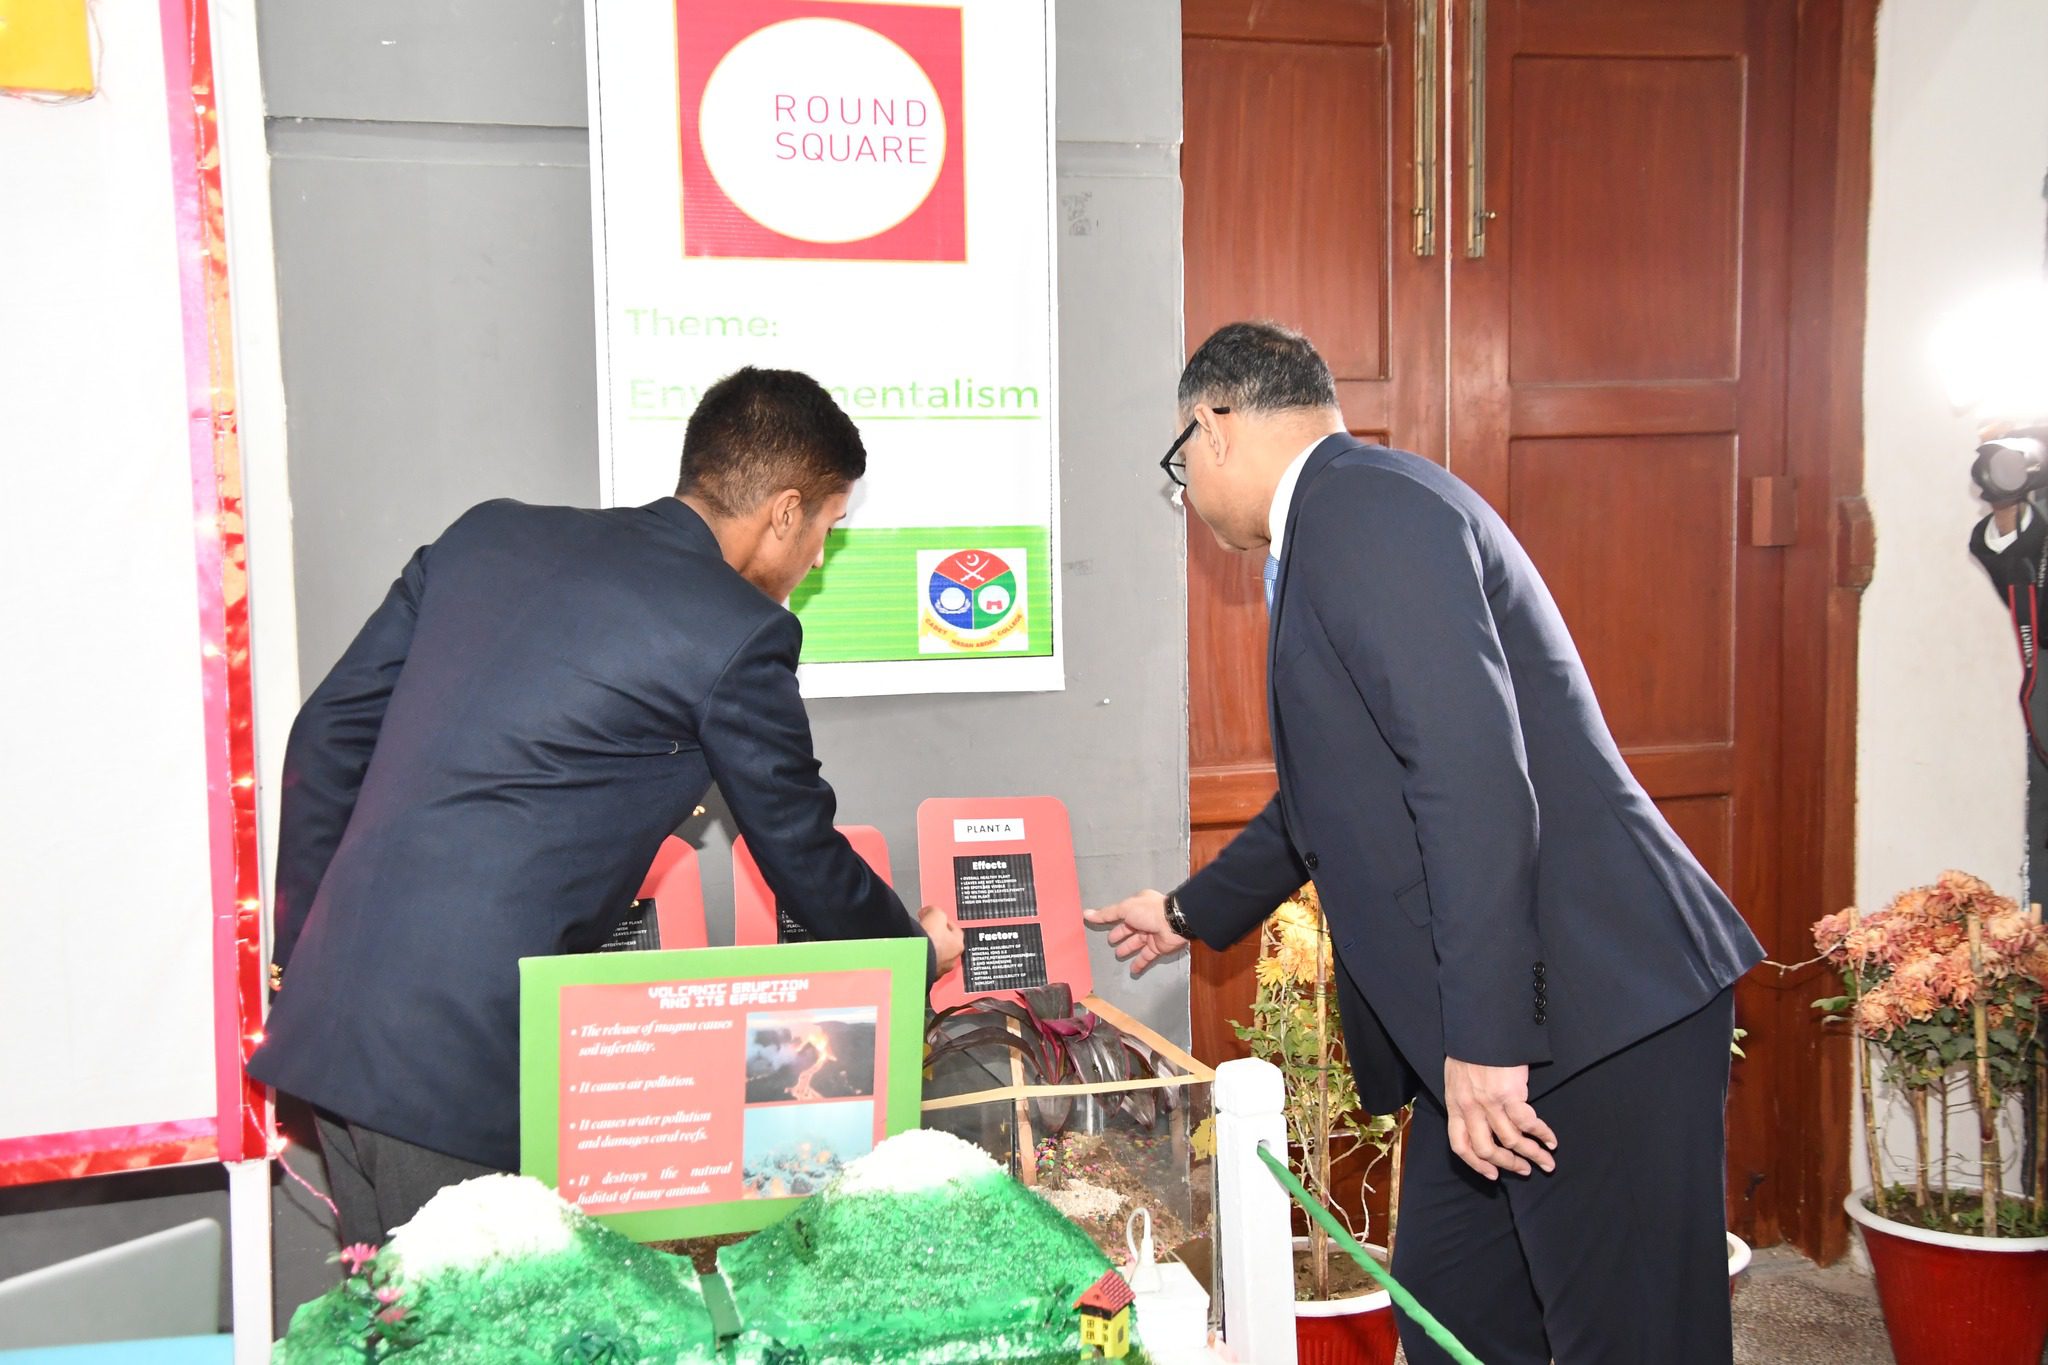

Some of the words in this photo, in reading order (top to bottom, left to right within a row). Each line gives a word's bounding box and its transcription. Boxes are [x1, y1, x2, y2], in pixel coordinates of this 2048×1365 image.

[775, 94, 927, 127] ROUND
[776, 131, 928, 164] SQUARE
[624, 307, 779, 338] Theme:
[925, 618, 948, 635] CADET
[967, 824, 1000, 833] PLANT
[1004, 824, 1011, 832] A
[972, 860, 1007, 871] Effects
[978, 931, 1019, 942] Factors
[648, 983, 727, 999] VOLCANIC
[732, 978, 809, 994] ERUPTION
[660, 996, 690, 1009] AND
[695, 994, 724, 1008] ITS
[729, 990, 797, 1006] EFFECTS
[580, 1024, 602, 1038] The
[602, 1021, 640, 1037] release
[641, 1019, 655, 1036] of
[655, 1022, 696, 1034] magma
[697, 1018, 734, 1031] causes
[578, 1042, 600, 1057] soil
[600, 1039, 656, 1056] infertility.
[579, 1081, 589, 1094] It
[590, 1081, 626, 1093] causes
[627, 1077, 643, 1090] air
[643, 1074, 695, 1092] pollution.
[579, 1119, 589, 1131] It
[590, 1118, 626, 1130] causes
[627, 1113, 660, 1128] water
[660, 1109, 712, 1127] pollution
[577, 1135, 600, 1150] and
[600, 1132, 649, 1148] damages
[650, 1129, 678, 1144] coral
[679, 1127, 708, 1144] reefs.
[578, 1174, 589, 1187] It
[602, 1171, 648, 1185] destroys
[660, 1165, 679, 1181] the
[690, 1161, 734, 1177] natural
[577, 1190, 618, 1205] habitat
[619, 1186, 635, 1204] of
[632, 1186, 665, 1202] many
[665, 1181, 711, 1198] animals.
